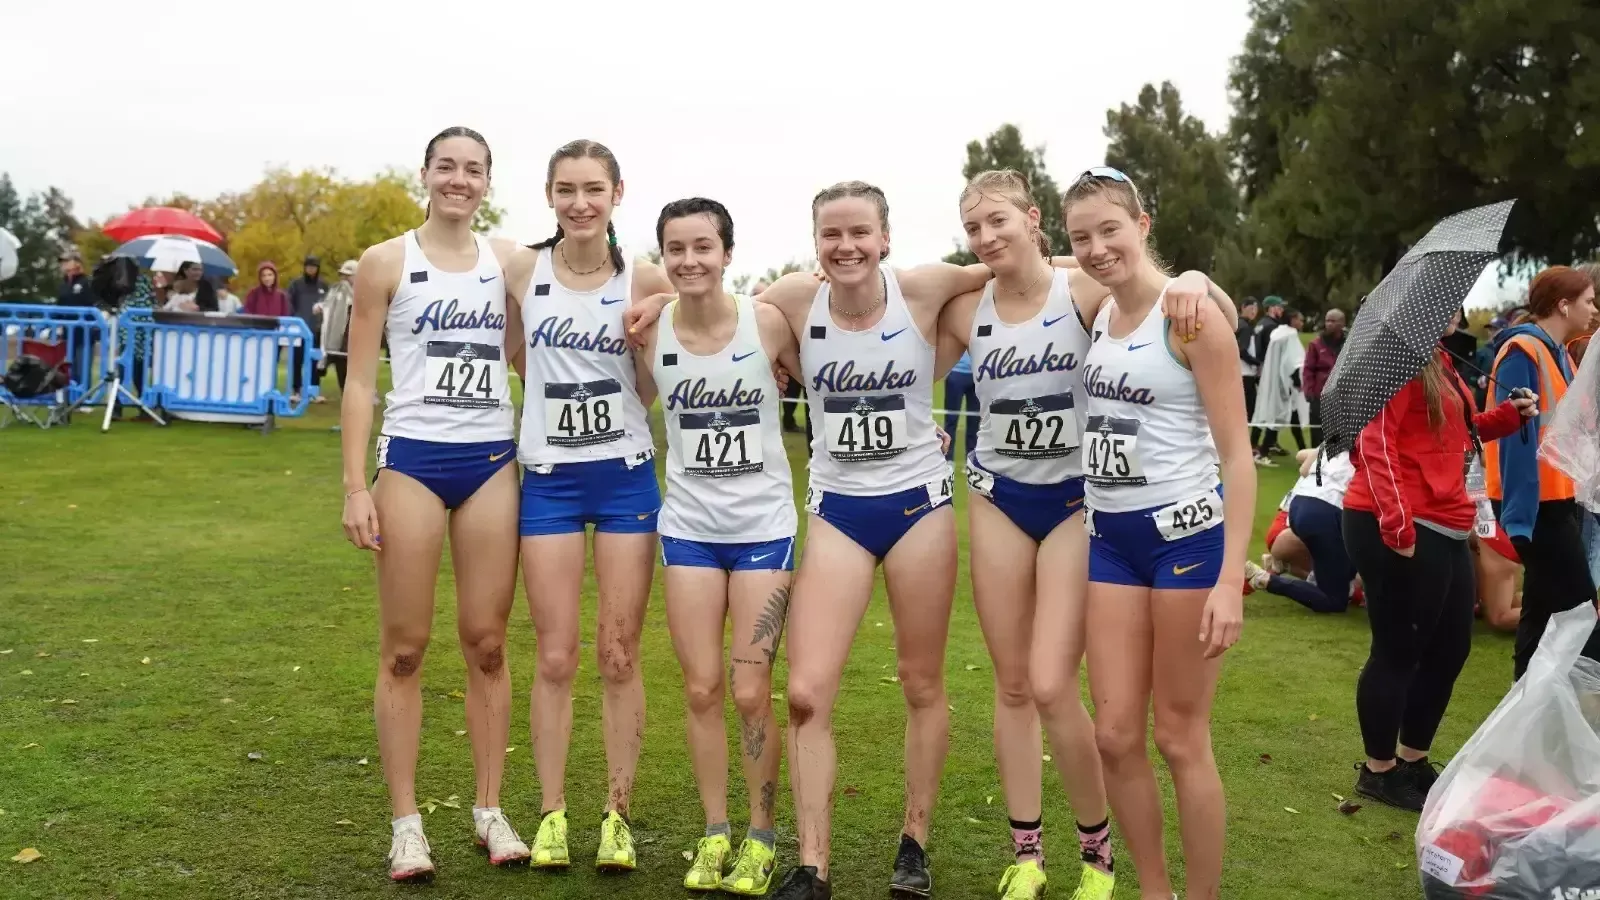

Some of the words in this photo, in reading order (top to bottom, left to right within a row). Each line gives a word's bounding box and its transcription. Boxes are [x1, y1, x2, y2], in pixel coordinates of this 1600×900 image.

[411, 299, 505, 335] Alaska
[530, 316, 628, 356] Alaska
[436, 362, 493, 398] 424
[812, 360, 917, 393] Alaska
[976, 342, 1079, 382] Alaska
[666, 377, 765, 411] Alaska
[558, 399, 612, 437] 418
[838, 415, 893, 452] 419
[1005, 415, 1066, 450] 422
[695, 430, 751, 467] 421
[1088, 437, 1130, 477] 425
[1172, 498, 1213, 532] 425
